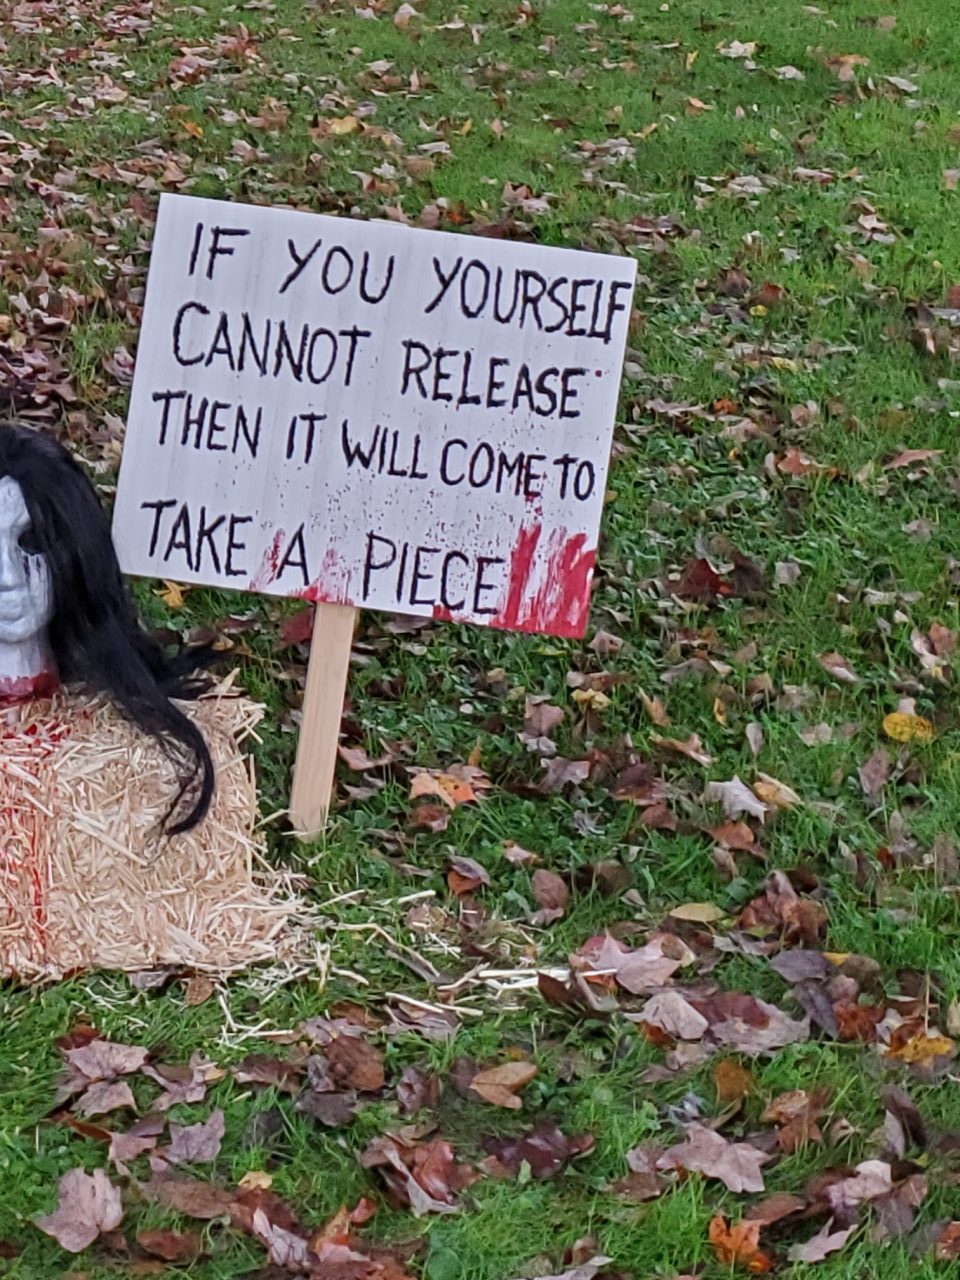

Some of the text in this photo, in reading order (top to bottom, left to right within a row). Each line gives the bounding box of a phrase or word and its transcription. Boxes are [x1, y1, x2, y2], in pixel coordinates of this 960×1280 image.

[188, 222, 632, 344] IF YOU YOURSELF
[172, 302, 586, 418] CANNOT RELEASE
[152, 390, 595, 501] THEN IT WILL COME TO
[140, 499, 504, 614] TAKE A PIECE
